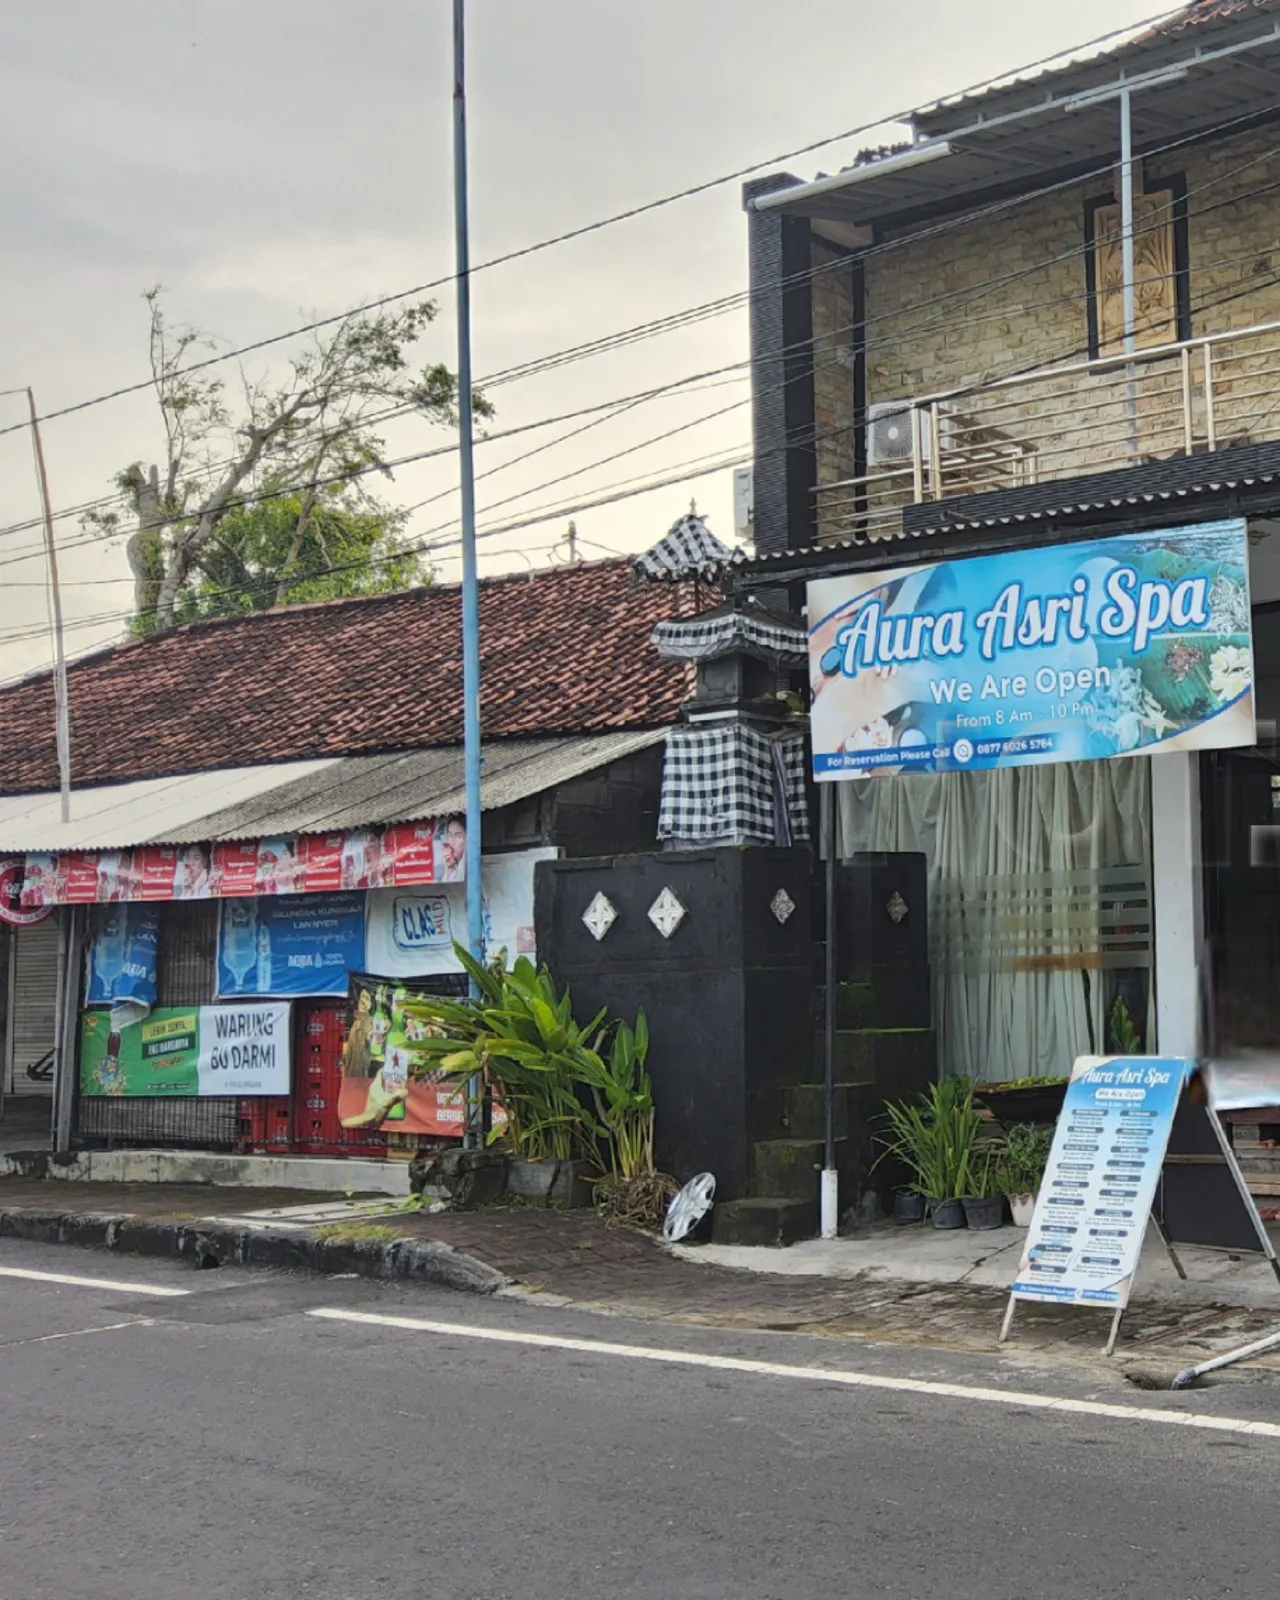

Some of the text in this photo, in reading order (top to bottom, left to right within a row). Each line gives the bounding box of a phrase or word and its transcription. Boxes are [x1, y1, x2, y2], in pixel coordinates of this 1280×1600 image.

[838, 567, 1210, 678] Aura Asri Spa
[930, 666, 1112, 704] We Are Open
[956, 713, 992, 729] From
[995, 711, 1005, 725] 8
[1008, 709, 1033, 724] Am
[1050, 705, 1067, 719] 10
[1068, 702, 1094, 718] Pm
[827, 756, 842, 768] For
[844, 752, 899, 766] Reservation
[900, 750, 930, 762] Please
[932, 747, 950, 758] Call
[214, 1012, 275, 1040] WARUNG
[210, 1045, 229, 1070] BU
[231, 1044, 276, 1069] DARMI
[1082, 1067, 1170, 1088] Aura Asri Spa
